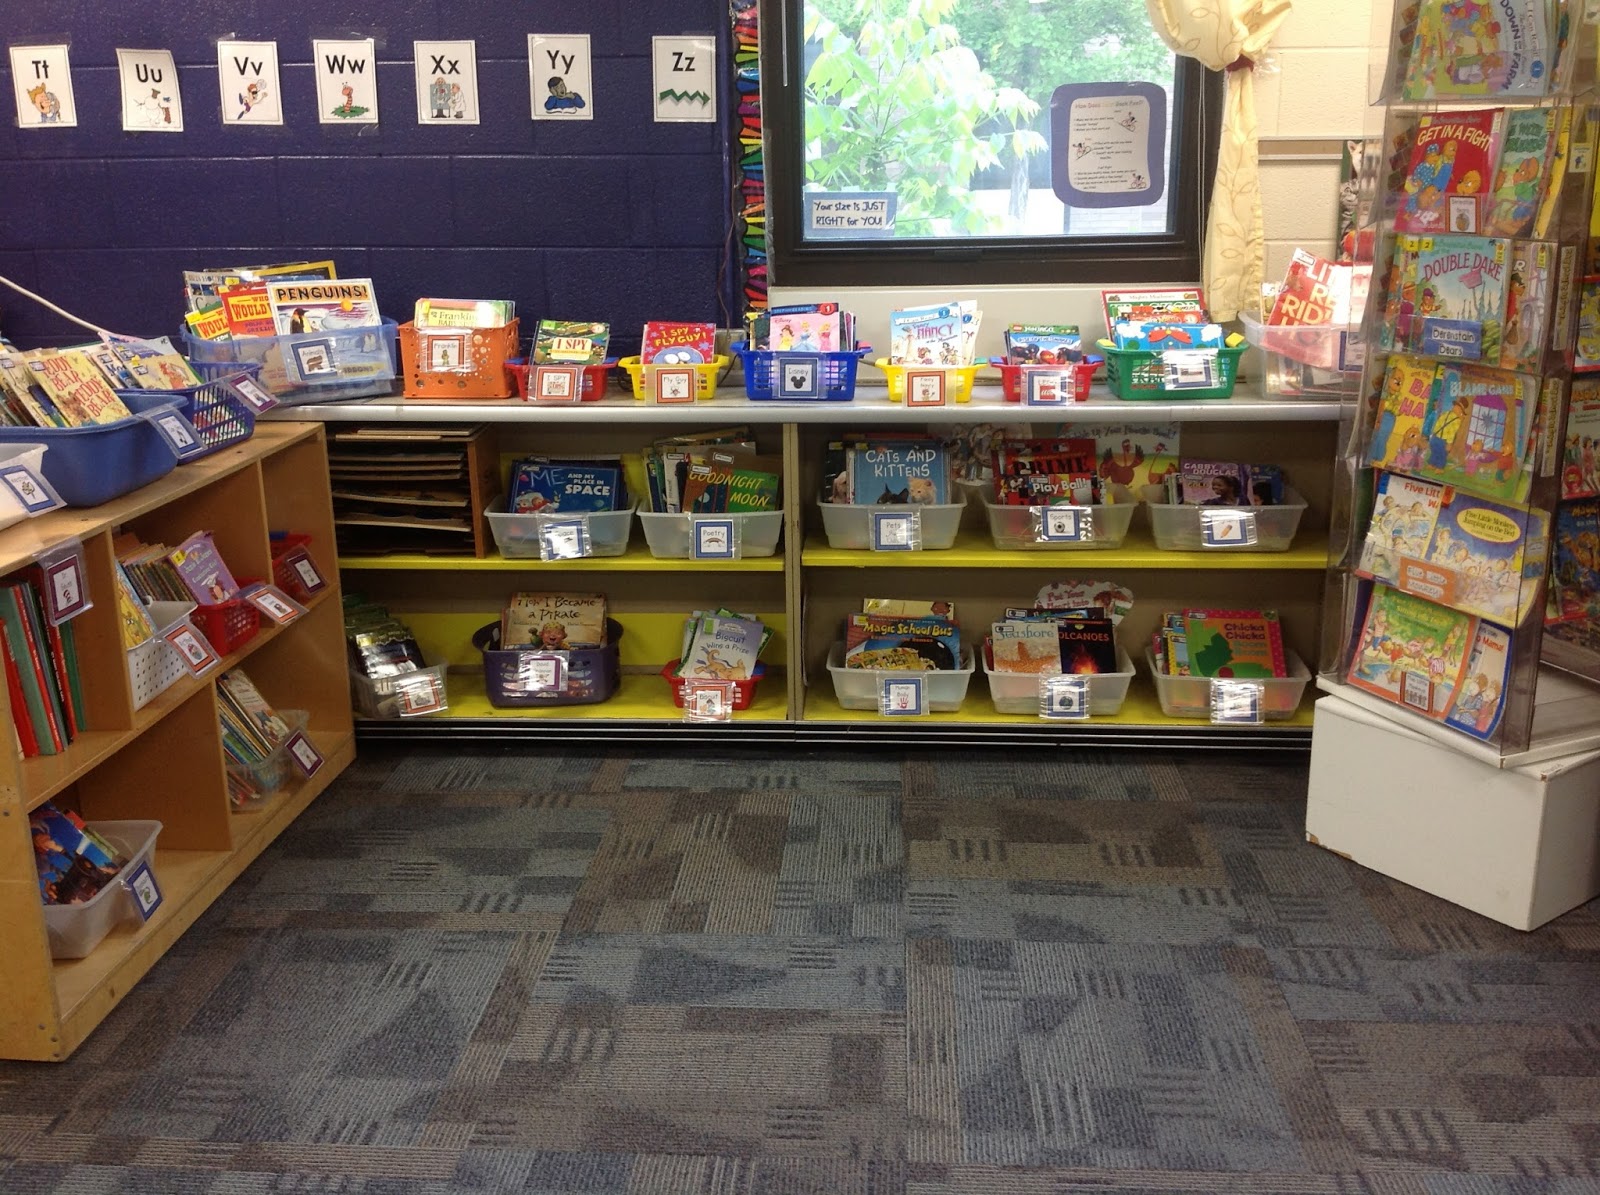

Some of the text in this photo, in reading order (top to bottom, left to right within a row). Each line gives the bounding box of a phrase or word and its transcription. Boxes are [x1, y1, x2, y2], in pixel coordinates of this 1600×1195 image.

[32, 59, 50, 80] Tt
[235, 57, 262, 75] Vv
[326, 54, 366, 74] Ww
[431, 55, 460, 75] Xx
[546, 50, 575, 74] Yy
[672, 52, 695, 72] Zz
[135, 63, 163, 83] Uu
[1502, 52, 1522, 90] FARM
[1417, 126, 1442, 146] GET
[1441, 124, 1456, 138] IN
[1453, 125, 1463, 139] A
[1463, 127, 1493, 152] FIGHT
[814, 202, 885, 211] Your size is JUST
[816, 216, 882, 226] RIGHT for YOU!
[1424, 252, 1470, 282] DOUBLE
[1473, 253, 1503, 281] DARE
[276, 284, 369, 302] PENGUINS!
[231, 303, 267, 320] WOULD
[198, 318, 229, 338] WOUL
[670, 327, 689, 336] SPY
[917, 323, 954, 339] NANCY
[1433, 329, 1474, 341] Berenstain
[557, 337, 588, 350] I SPY
[655, 332, 707, 346] FLY GUY!
[1440, 343, 1462, 356] Bears
[44, 356, 73, 378] EDDY
[788, 368, 808, 376] Disney
[51, 370, 83, 391] BEAR
[74, 376, 105, 406] TEDDY
[87, 390, 116, 418] BEAR
[905, 449, 936, 462] AND
[1012, 458, 1089, 474] PRIME
[530, 468, 566, 487] ME
[689, 471, 764, 491] GOODNIGHT
[1032, 478, 1088, 493] Play Ball!
[565, 484, 610, 496] SPACE
[1405, 482, 1440, 498] Five Litt
[729, 492, 770, 507] MOON
[1049, 513, 1071, 521] Sports
[702, 529, 725, 539] Poetry
[518, 597, 596, 608] How I Became
[864, 623, 952, 636] Magic School Bus
[997, 624, 1055, 640] Seashore
[1058, 632, 1110, 641] OLCANOES
[716, 632, 746, 644] Biscuit
[732, 644, 749, 654] Prize
